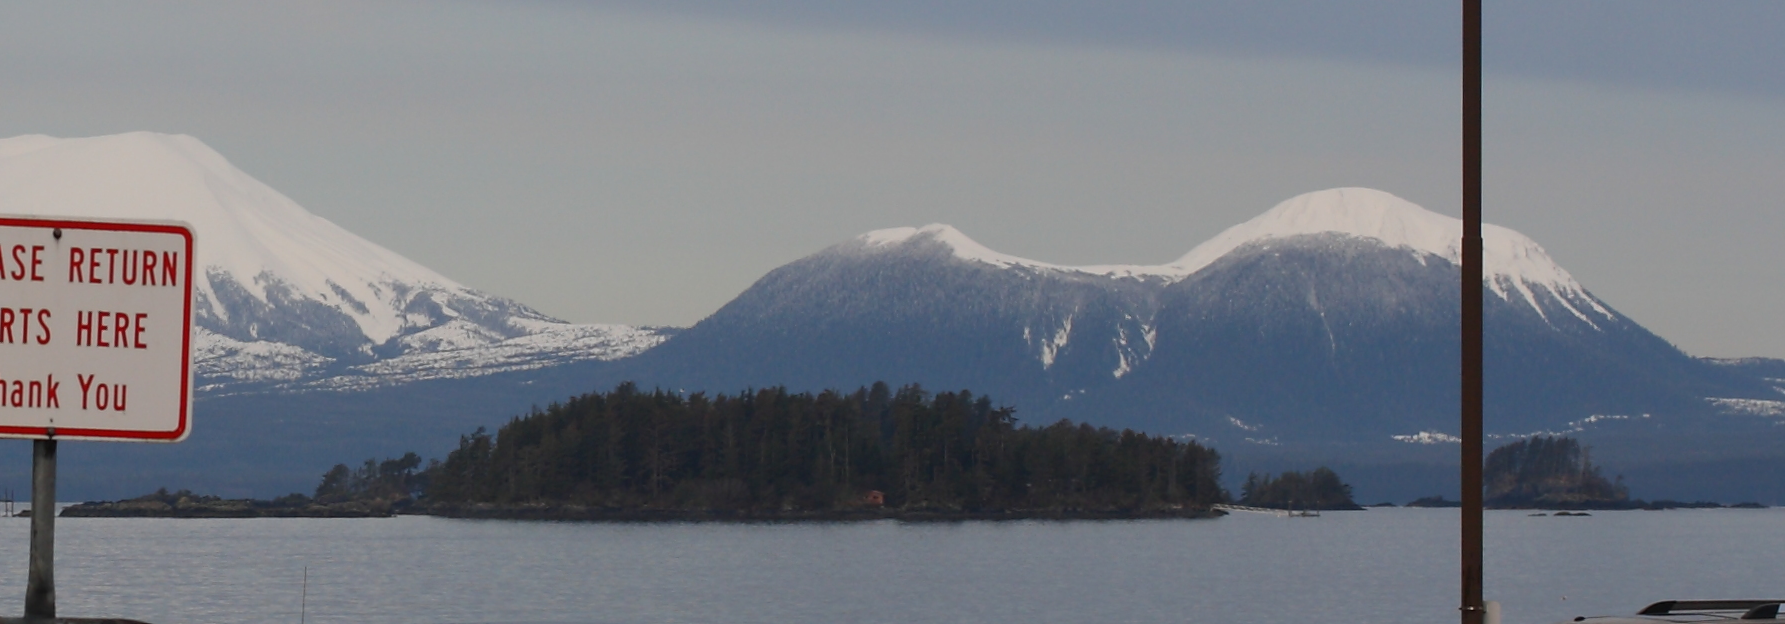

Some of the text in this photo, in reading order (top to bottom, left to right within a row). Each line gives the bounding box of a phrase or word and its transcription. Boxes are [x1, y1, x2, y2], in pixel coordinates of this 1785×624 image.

[69, 247, 178, 287] RETURN
[76, 311, 148, 349] HERE
[77, 374, 128, 412] You
